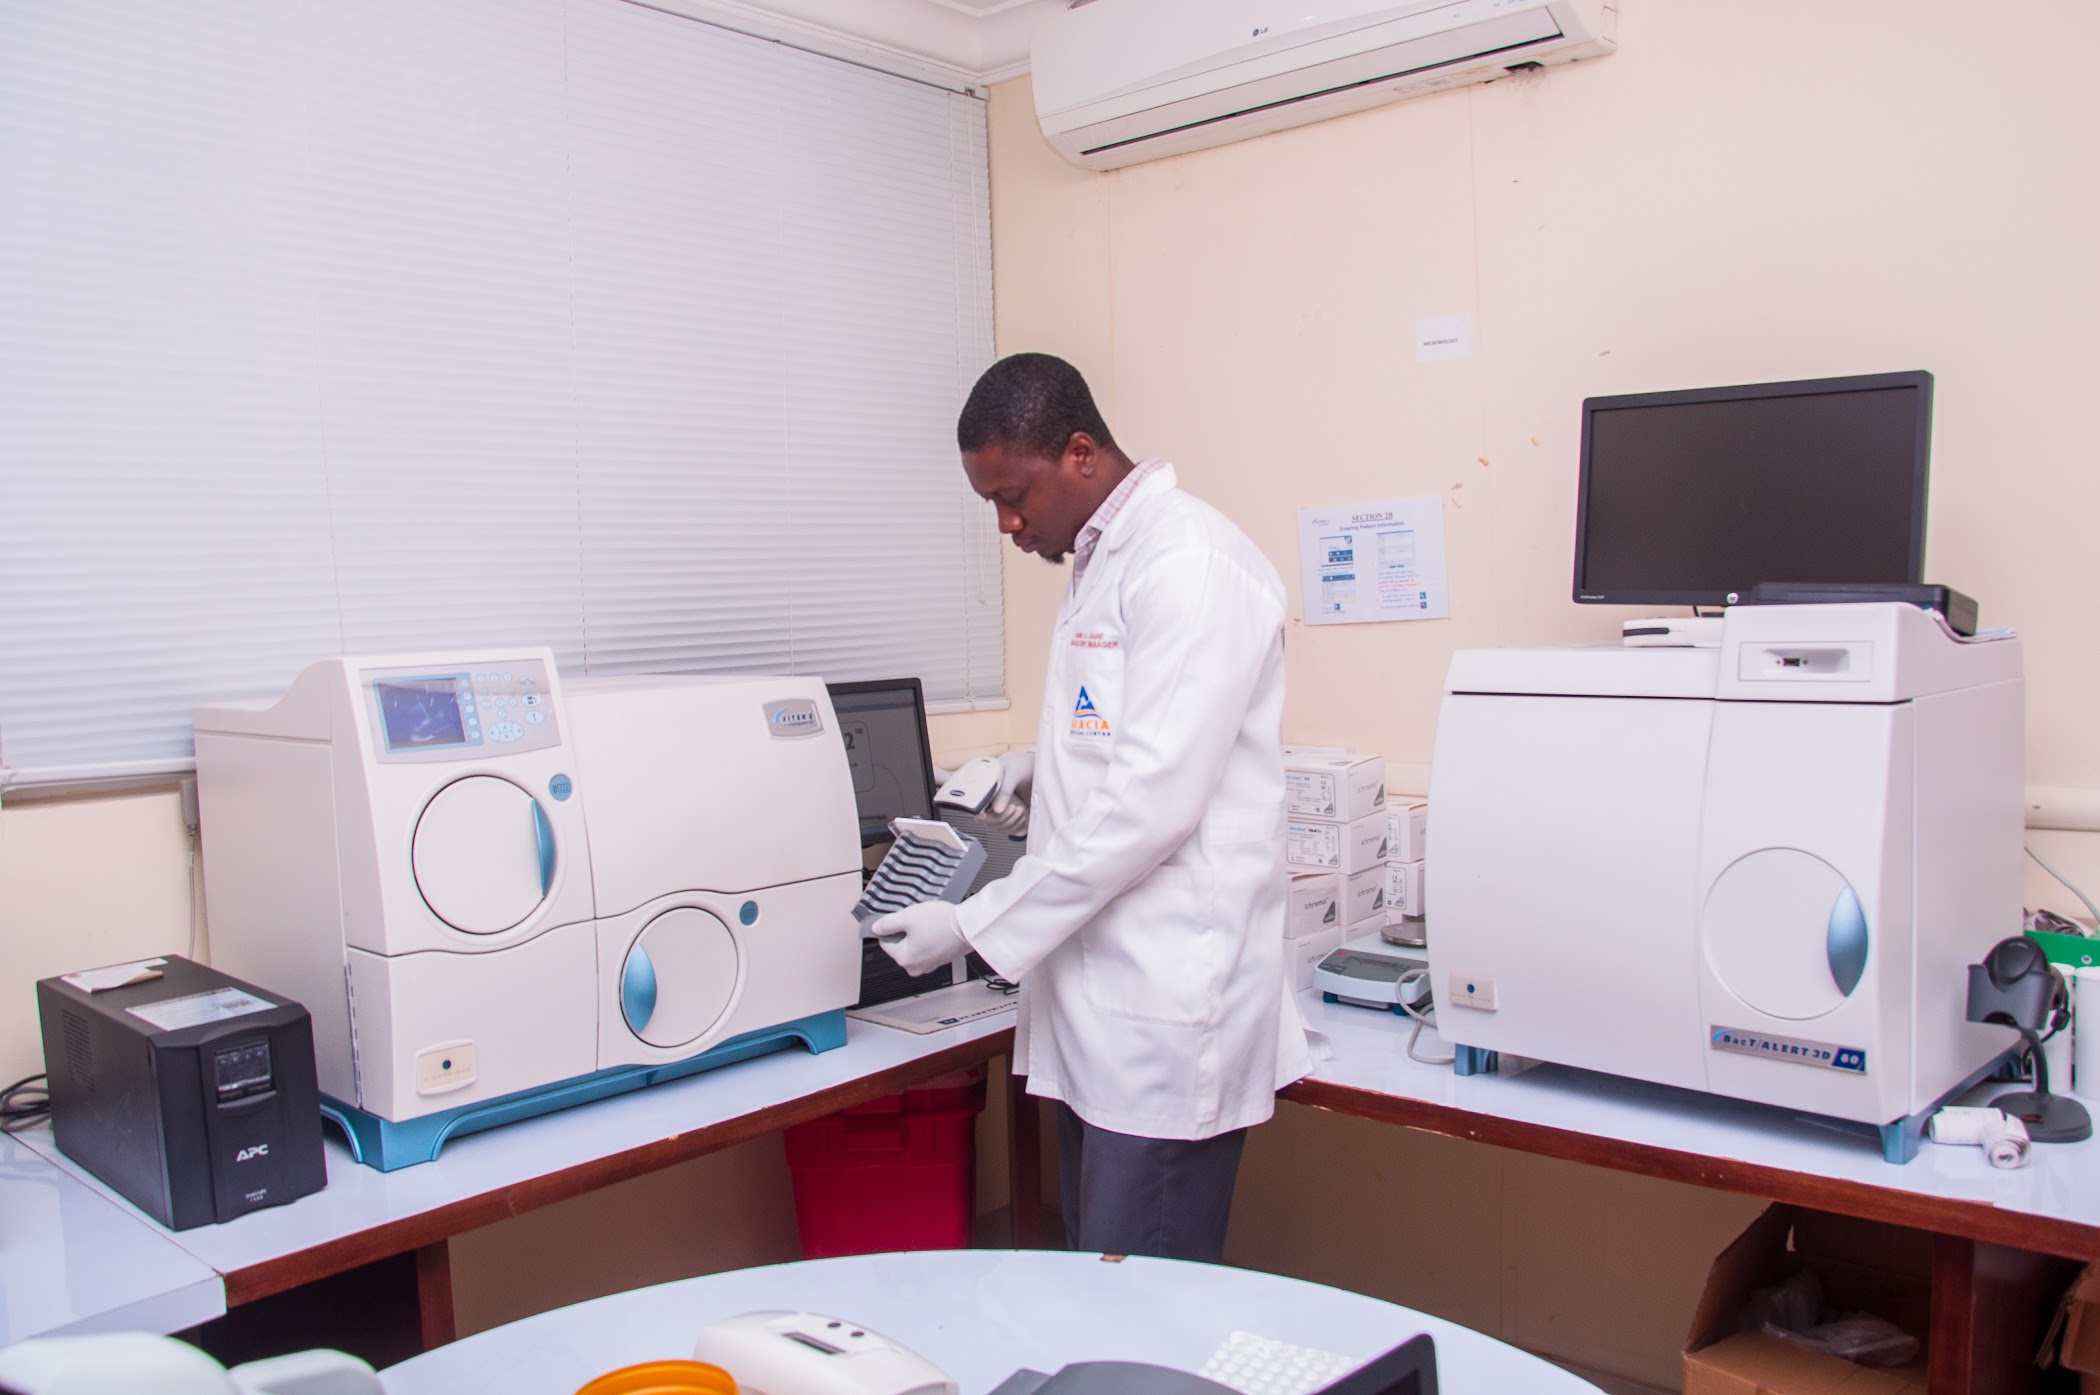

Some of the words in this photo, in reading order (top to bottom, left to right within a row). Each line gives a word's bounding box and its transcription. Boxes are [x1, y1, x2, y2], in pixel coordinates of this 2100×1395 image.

[1352, 512, 1383, 522] SECTION
[782, 714, 806, 722] VITEK
[1812, 1049, 1831, 1060] 3D
[236, 1143, 270, 1162] APC
